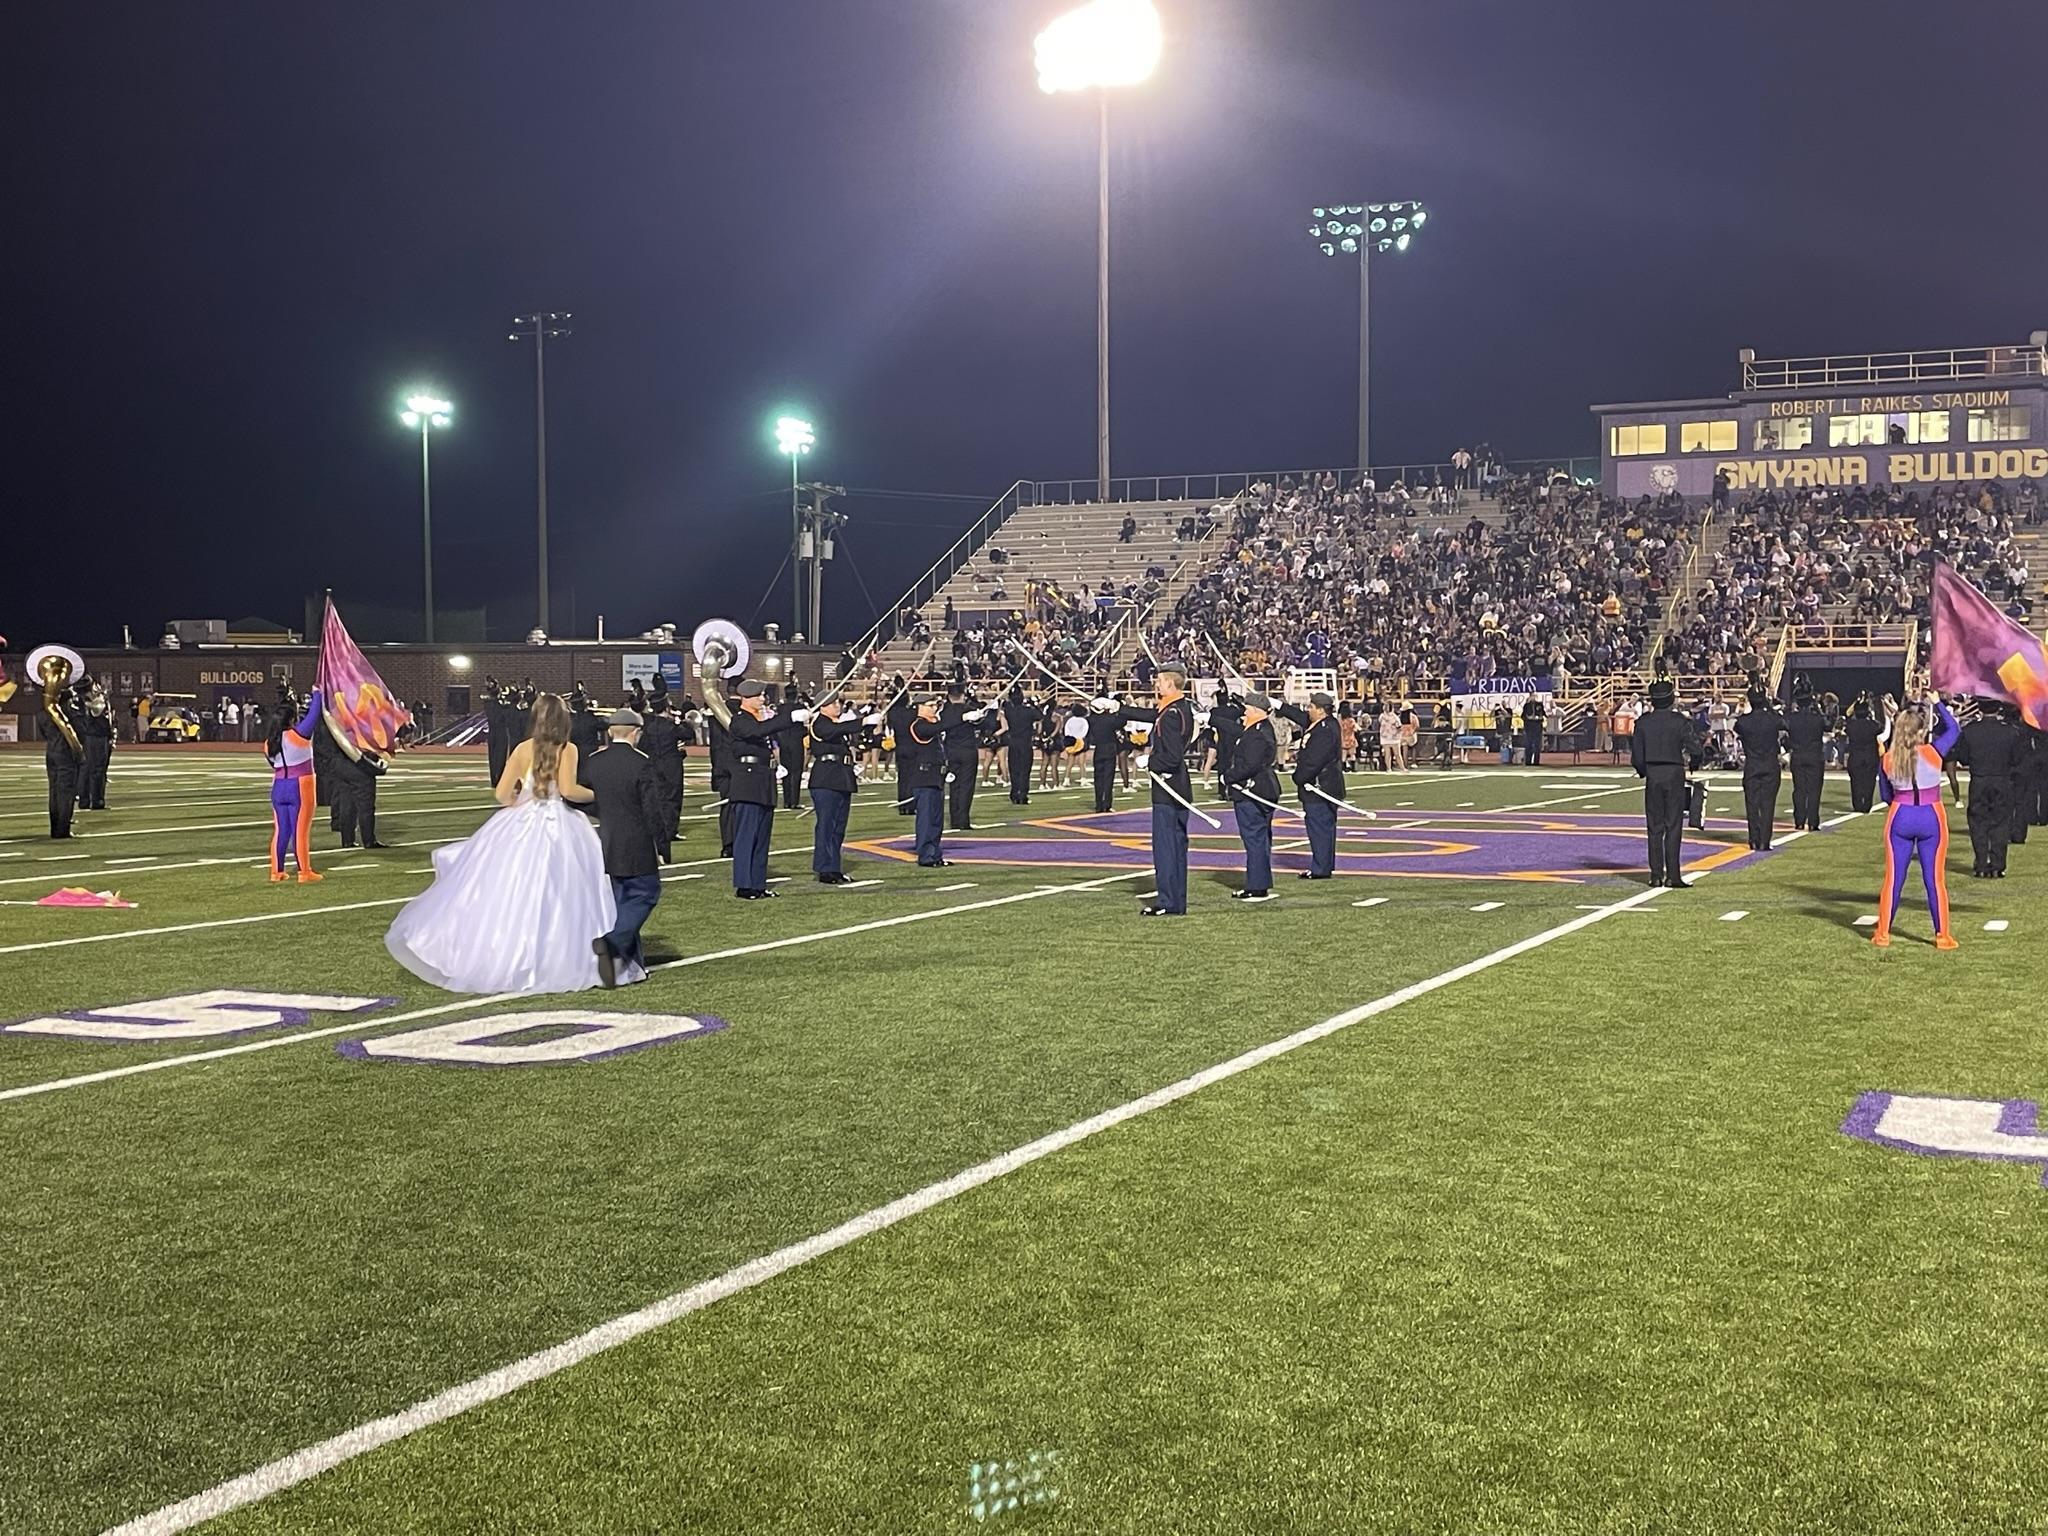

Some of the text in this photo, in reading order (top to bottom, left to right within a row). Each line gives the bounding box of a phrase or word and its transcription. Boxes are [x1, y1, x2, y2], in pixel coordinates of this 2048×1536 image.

[1771, 391, 2010, 417] ROBERT L RAIKES STADIUM
[1716, 449, 2048, 490] SMYRNA BULLDOG
[200, 671, 264, 684] BULLDOGS
[1468, 677, 1537, 693] RIDAYS
[1471, 696, 1493, 712] ARE
